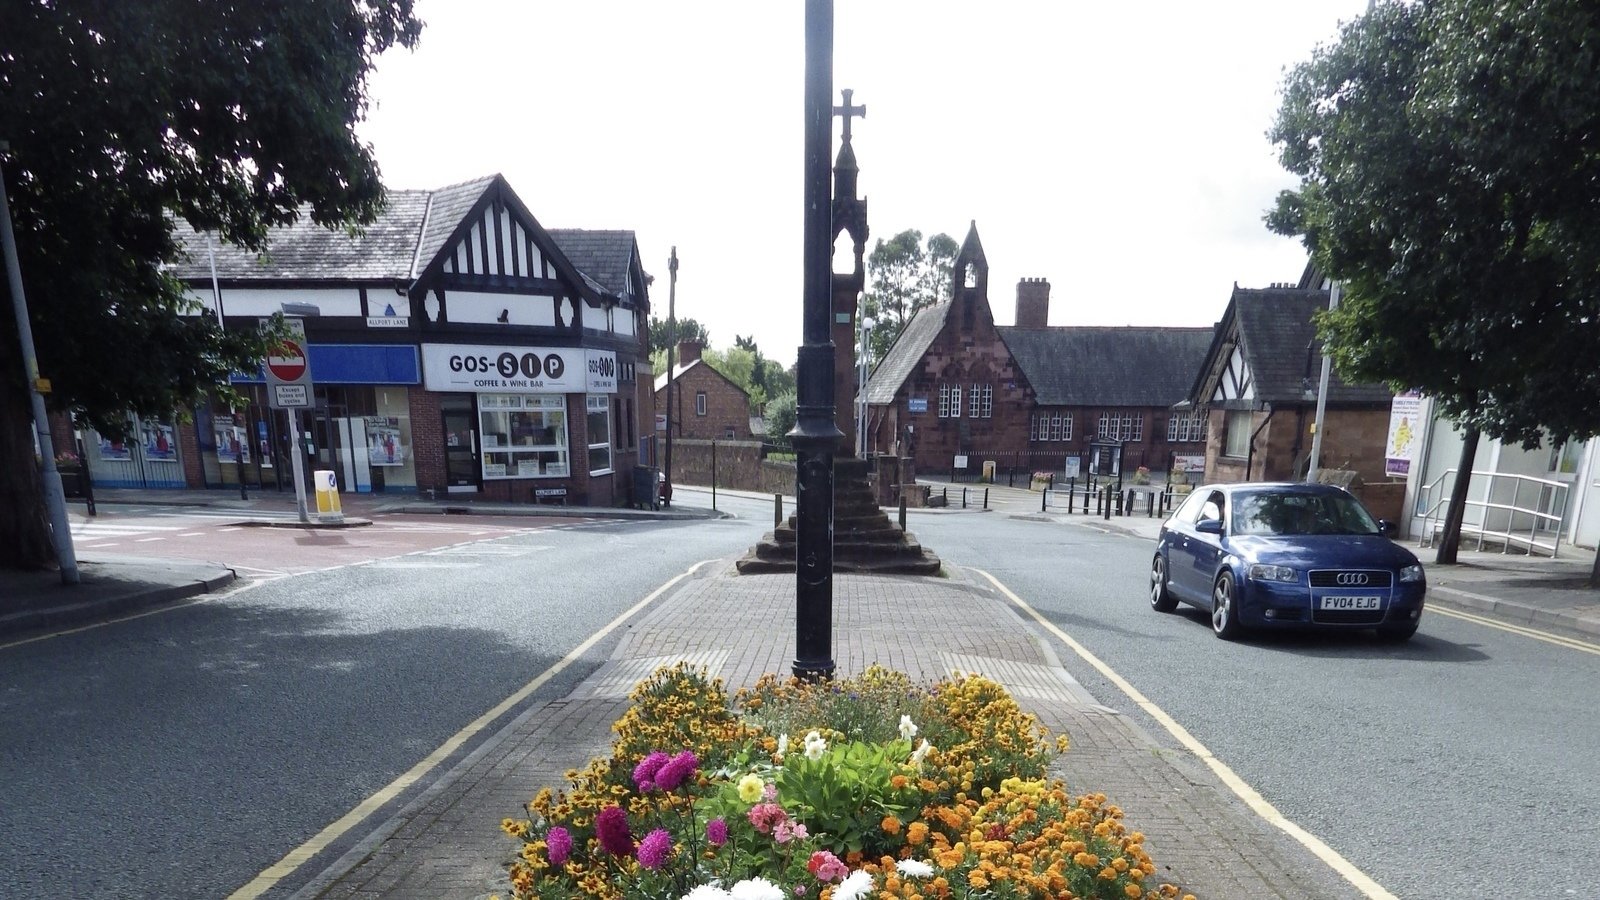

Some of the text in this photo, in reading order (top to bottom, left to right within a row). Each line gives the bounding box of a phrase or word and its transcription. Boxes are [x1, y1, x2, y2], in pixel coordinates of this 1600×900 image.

[449, 352, 565, 379] GOS-SIP
[474, 380, 499, 388] COFFEE
[501, 380, 508, 388] &
[510, 380, 528, 388] WINE
[1324, 597, 1377, 608] FV04 EJG
